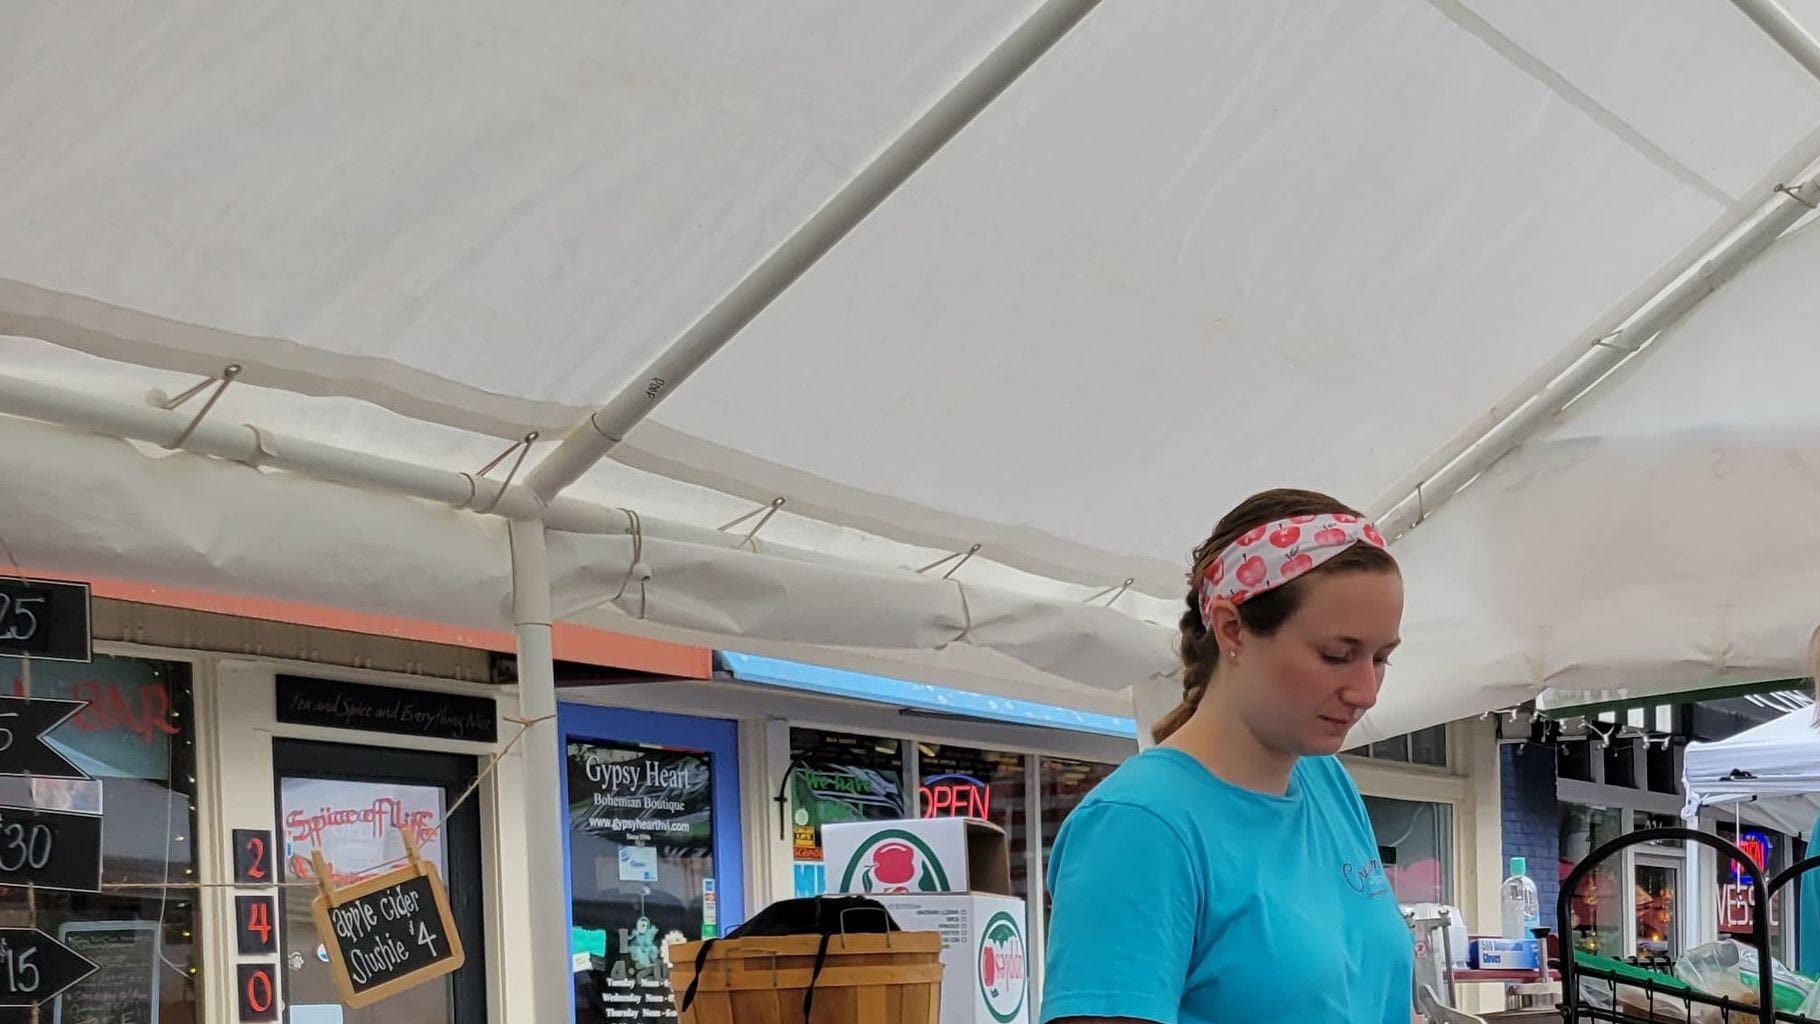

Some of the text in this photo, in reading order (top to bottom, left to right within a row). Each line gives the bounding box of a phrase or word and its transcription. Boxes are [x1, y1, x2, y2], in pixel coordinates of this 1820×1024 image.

[337, 699, 372, 722] Spice
[375, 700, 400, 717] and
[401, 704, 463, 738] Everything
[586, 755, 690, 791] Gypsy Heart
[593, 792, 685, 813] Bohemian Boutique
[332, 900, 378, 943] apple
[409, 920, 437, 957] $4
[606, 978, 635, 988] Tuesday
[641, 978, 660, 987] Noon
[602, 993, 642, 1004] Wednesday
[645, 994, 664, 1002] Noon
[605, 1008, 639, 1019] Thursday
[642, 1009, 661, 1017] Noon
